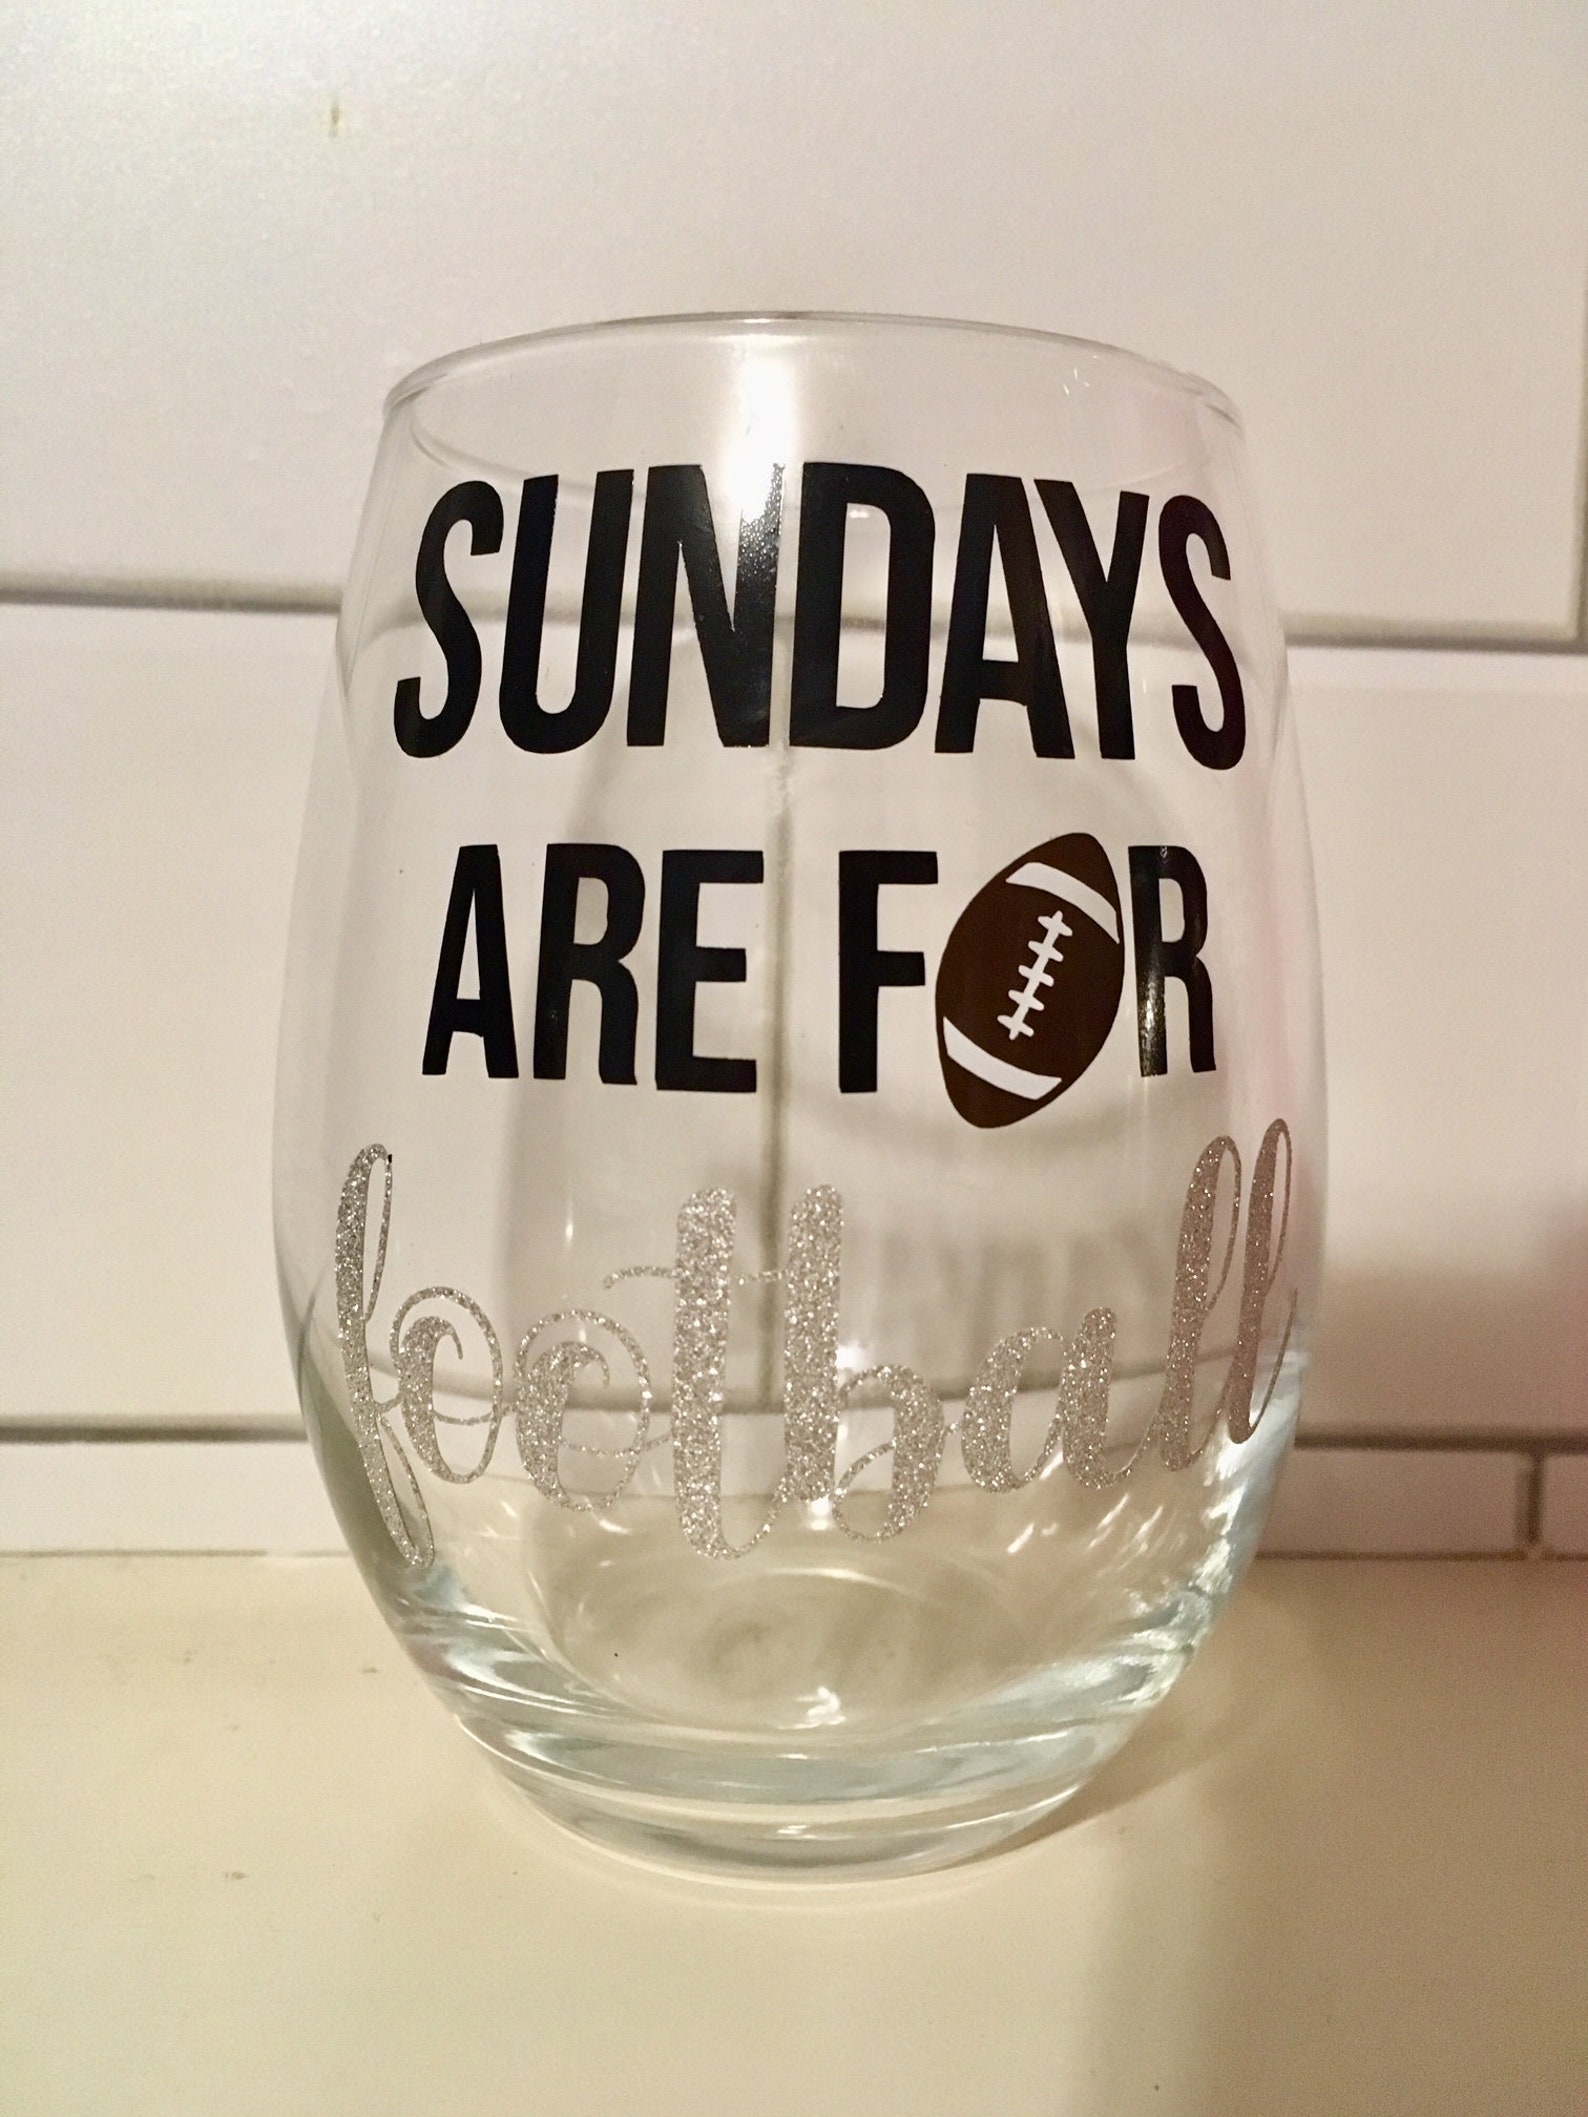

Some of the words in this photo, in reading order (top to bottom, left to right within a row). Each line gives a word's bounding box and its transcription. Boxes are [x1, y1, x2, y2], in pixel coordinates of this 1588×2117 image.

[393, 460, 1247, 771] SUNDAYS
[421, 842, 765, 1094] ARE
[335, 1117, 1299, 1568] football
